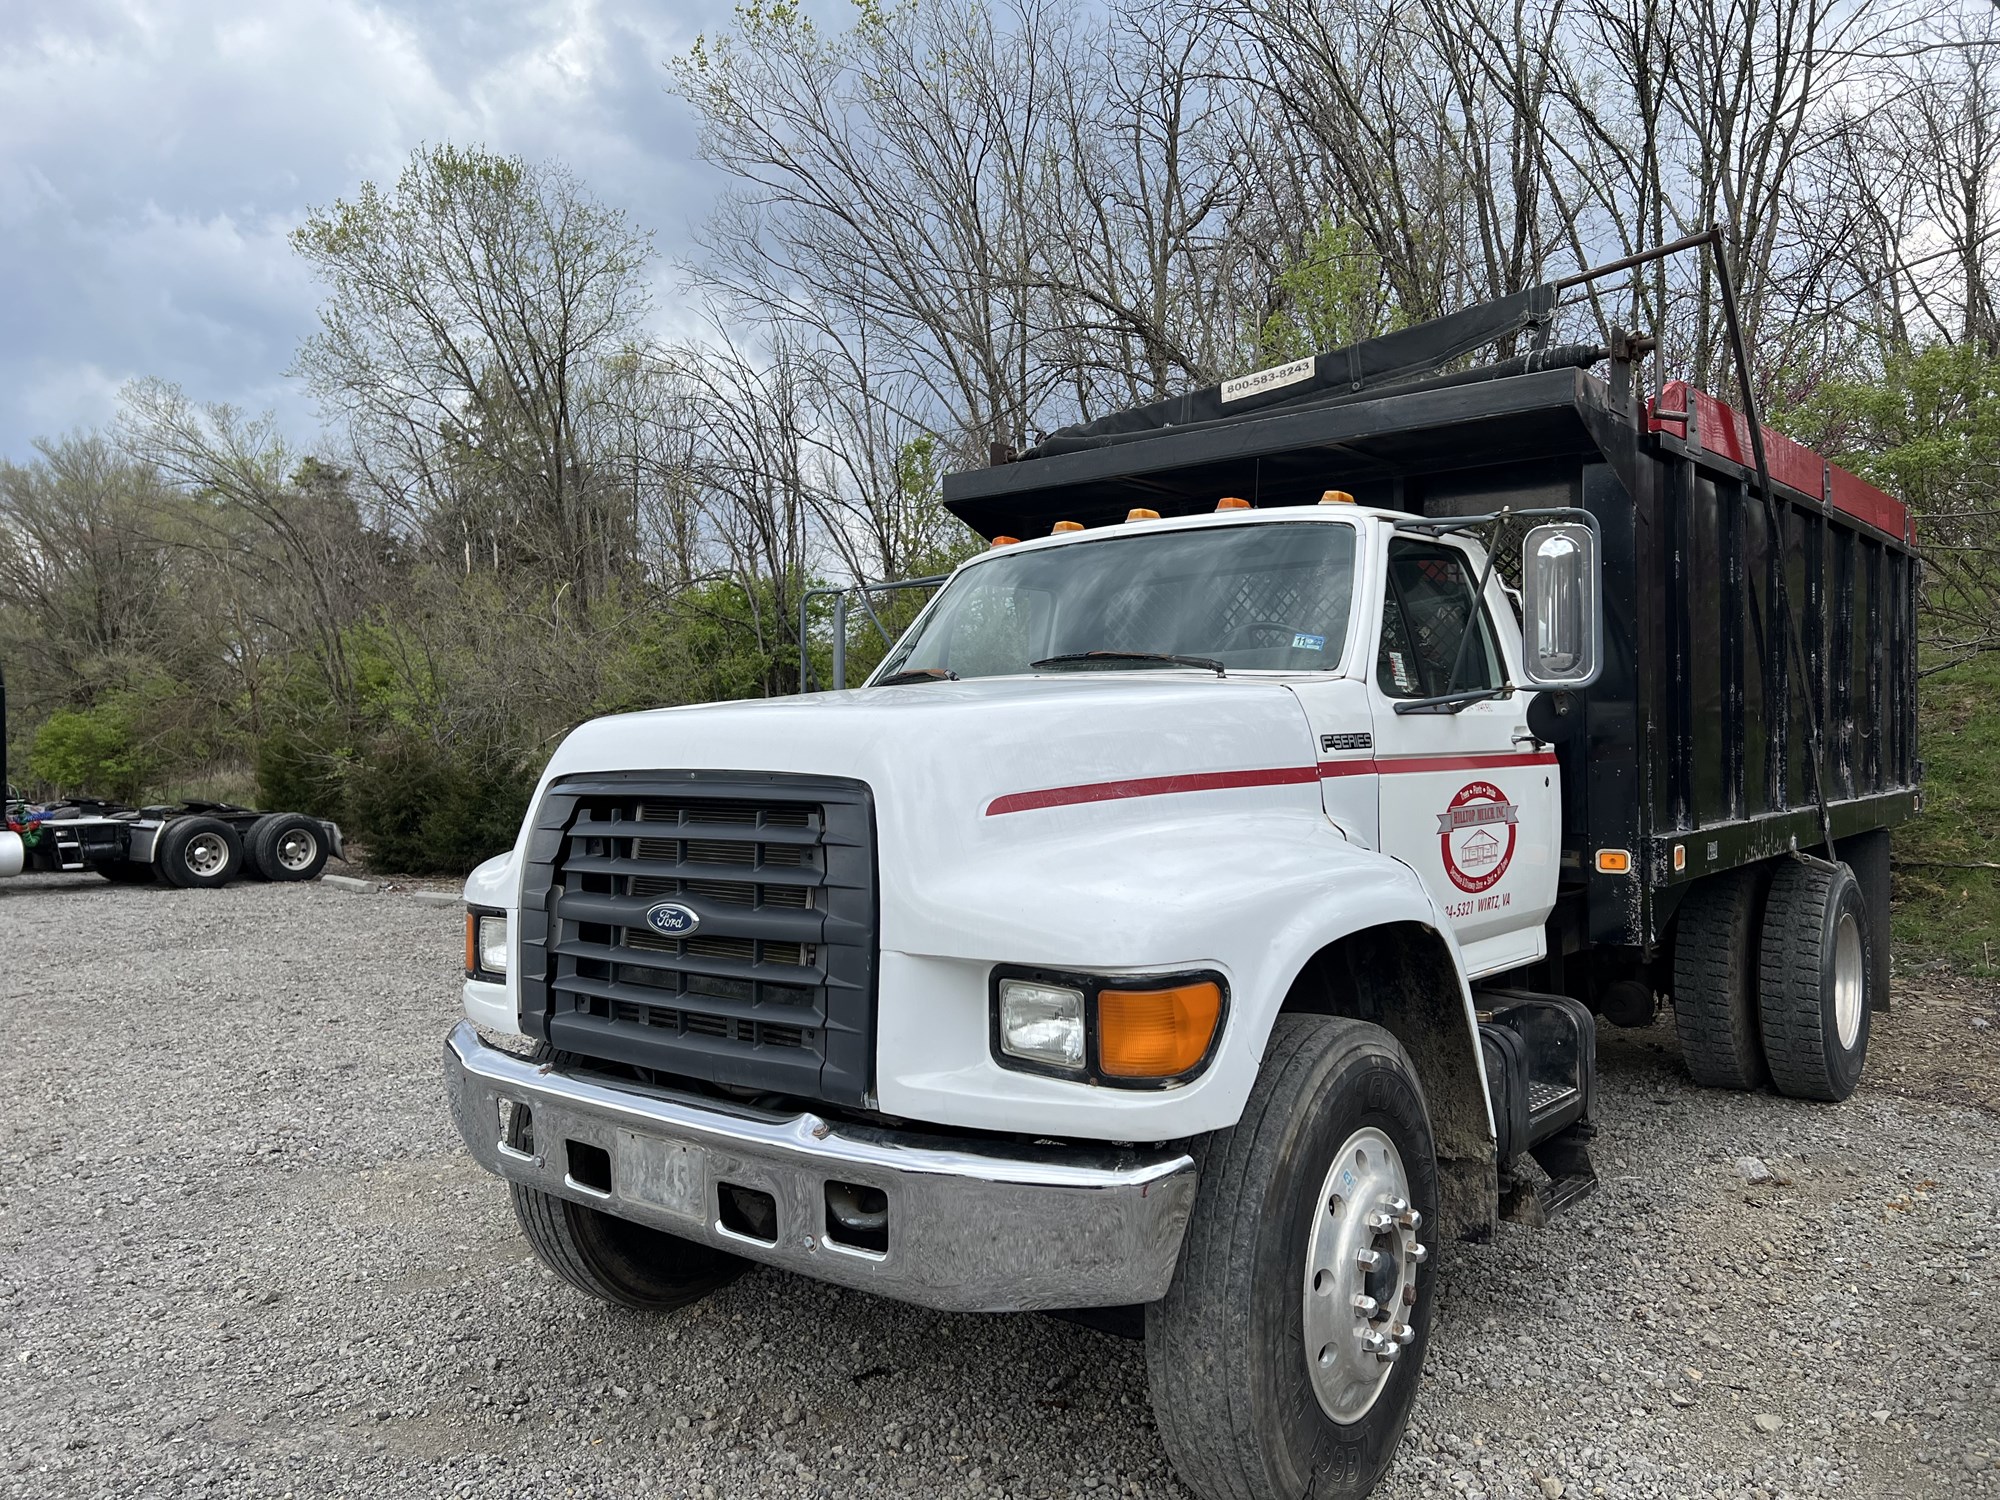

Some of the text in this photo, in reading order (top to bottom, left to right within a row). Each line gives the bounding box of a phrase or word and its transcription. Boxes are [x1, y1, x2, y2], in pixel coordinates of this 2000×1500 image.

[1227, 361, 1310, 394] 800-583-8243
[1453, 809, 1475, 824] HILLTOP
[1478, 895, 1500, 912] WIRTZ,
[1502, 892, 1511, 906] VA
[656, 909, 684, 928] Ford
